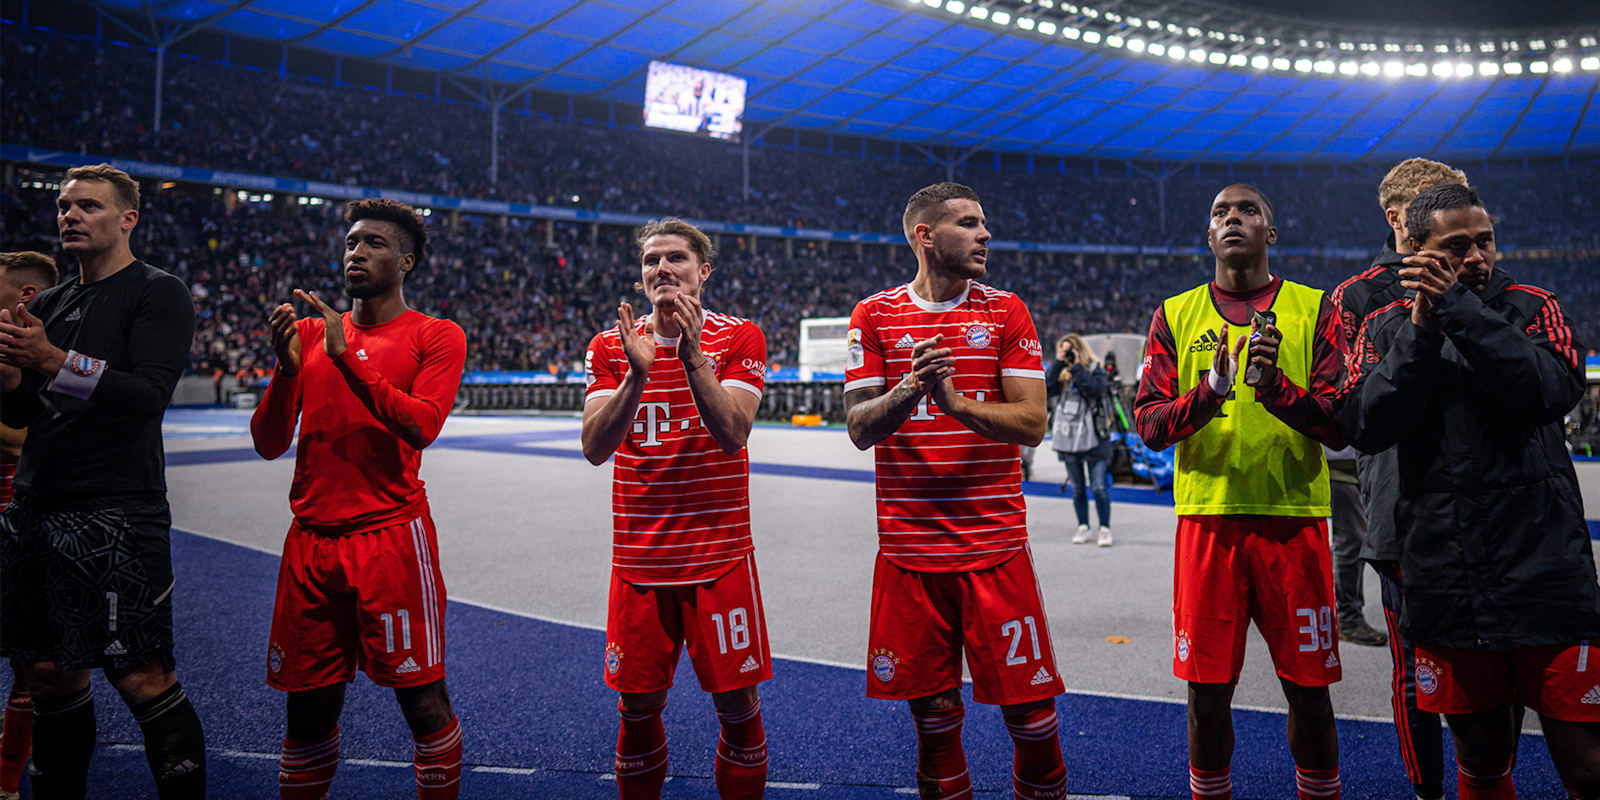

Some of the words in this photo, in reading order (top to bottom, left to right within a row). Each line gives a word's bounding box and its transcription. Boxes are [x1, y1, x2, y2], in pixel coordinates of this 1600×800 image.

[1019, 338, 1042, 350] QATA
[105, 591, 118, 631] 1
[380, 609, 412, 653] 11
[711, 607, 750, 654] 18
[1296, 606, 1332, 652] 39
[1001, 616, 1041, 666] 21
